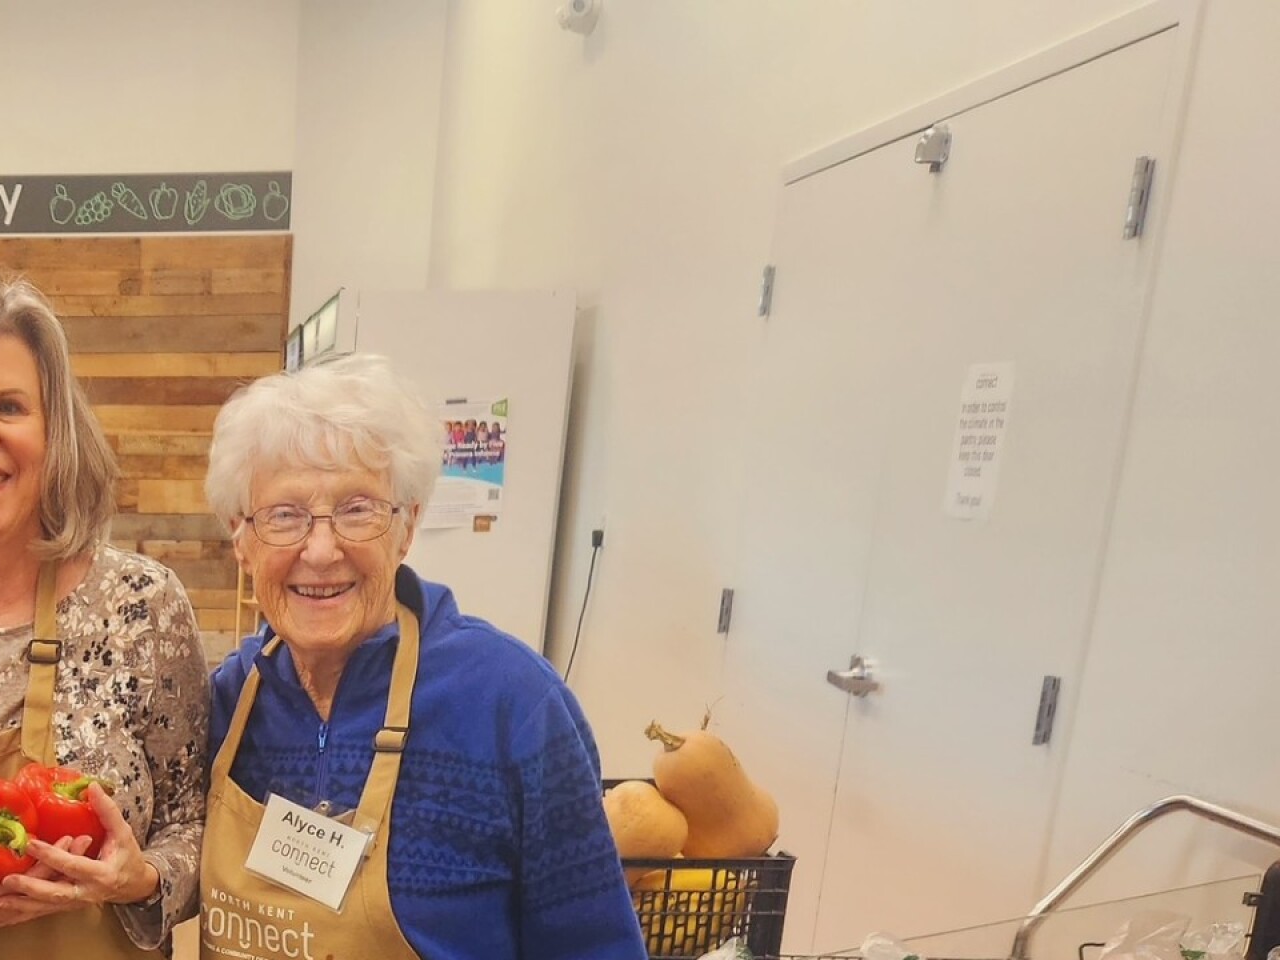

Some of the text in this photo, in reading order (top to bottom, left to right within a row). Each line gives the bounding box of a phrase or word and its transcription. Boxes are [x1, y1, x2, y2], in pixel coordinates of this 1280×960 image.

[281, 811, 345, 849] Alyce H.
[272, 839, 336, 879] connect
[211, 887, 295, 921] NORTH KENT
